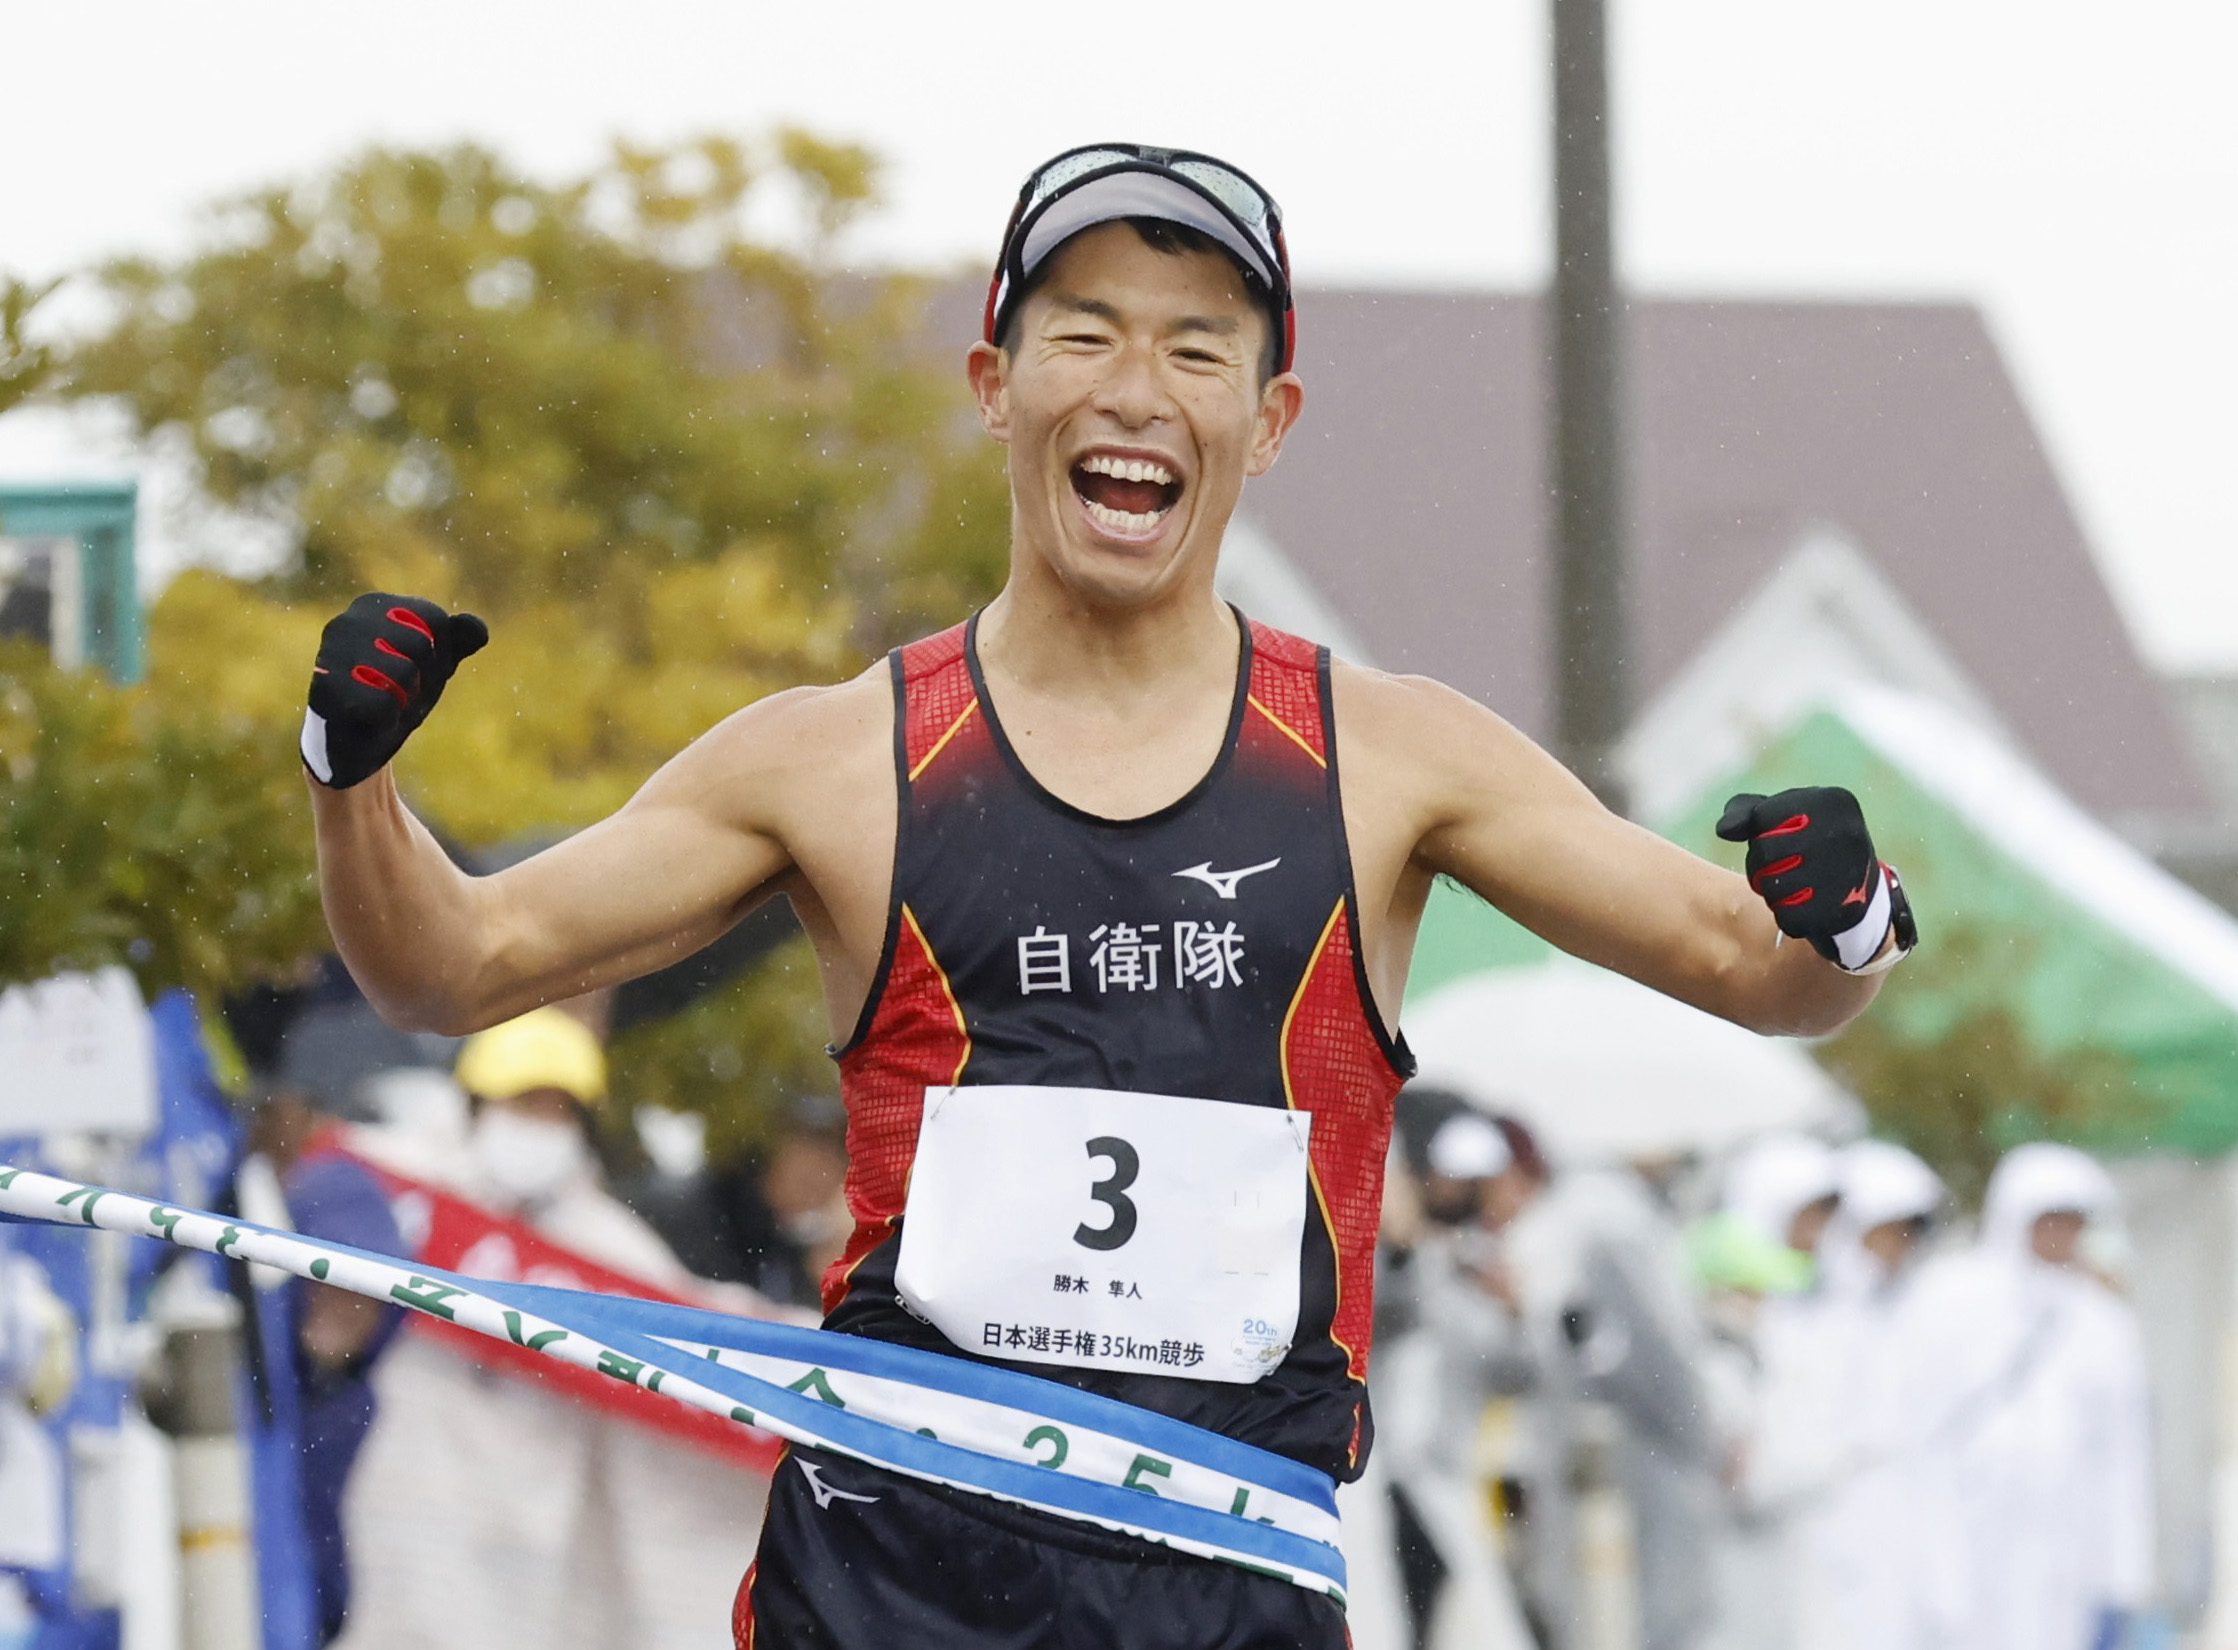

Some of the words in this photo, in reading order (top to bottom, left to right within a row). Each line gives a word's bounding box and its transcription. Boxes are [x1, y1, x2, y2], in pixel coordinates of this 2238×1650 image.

[1017, 920, 1246, 996] 自衛隊
[1072, 1136, 1140, 1251] 3
[1053, 1274, 1089, 1294] 勝木
[1108, 1280, 1143, 1300] 隼人
[982, 1322, 1206, 1368] 日本選手権35km競歩
[1242, 1318, 1278, 1337] 20th
